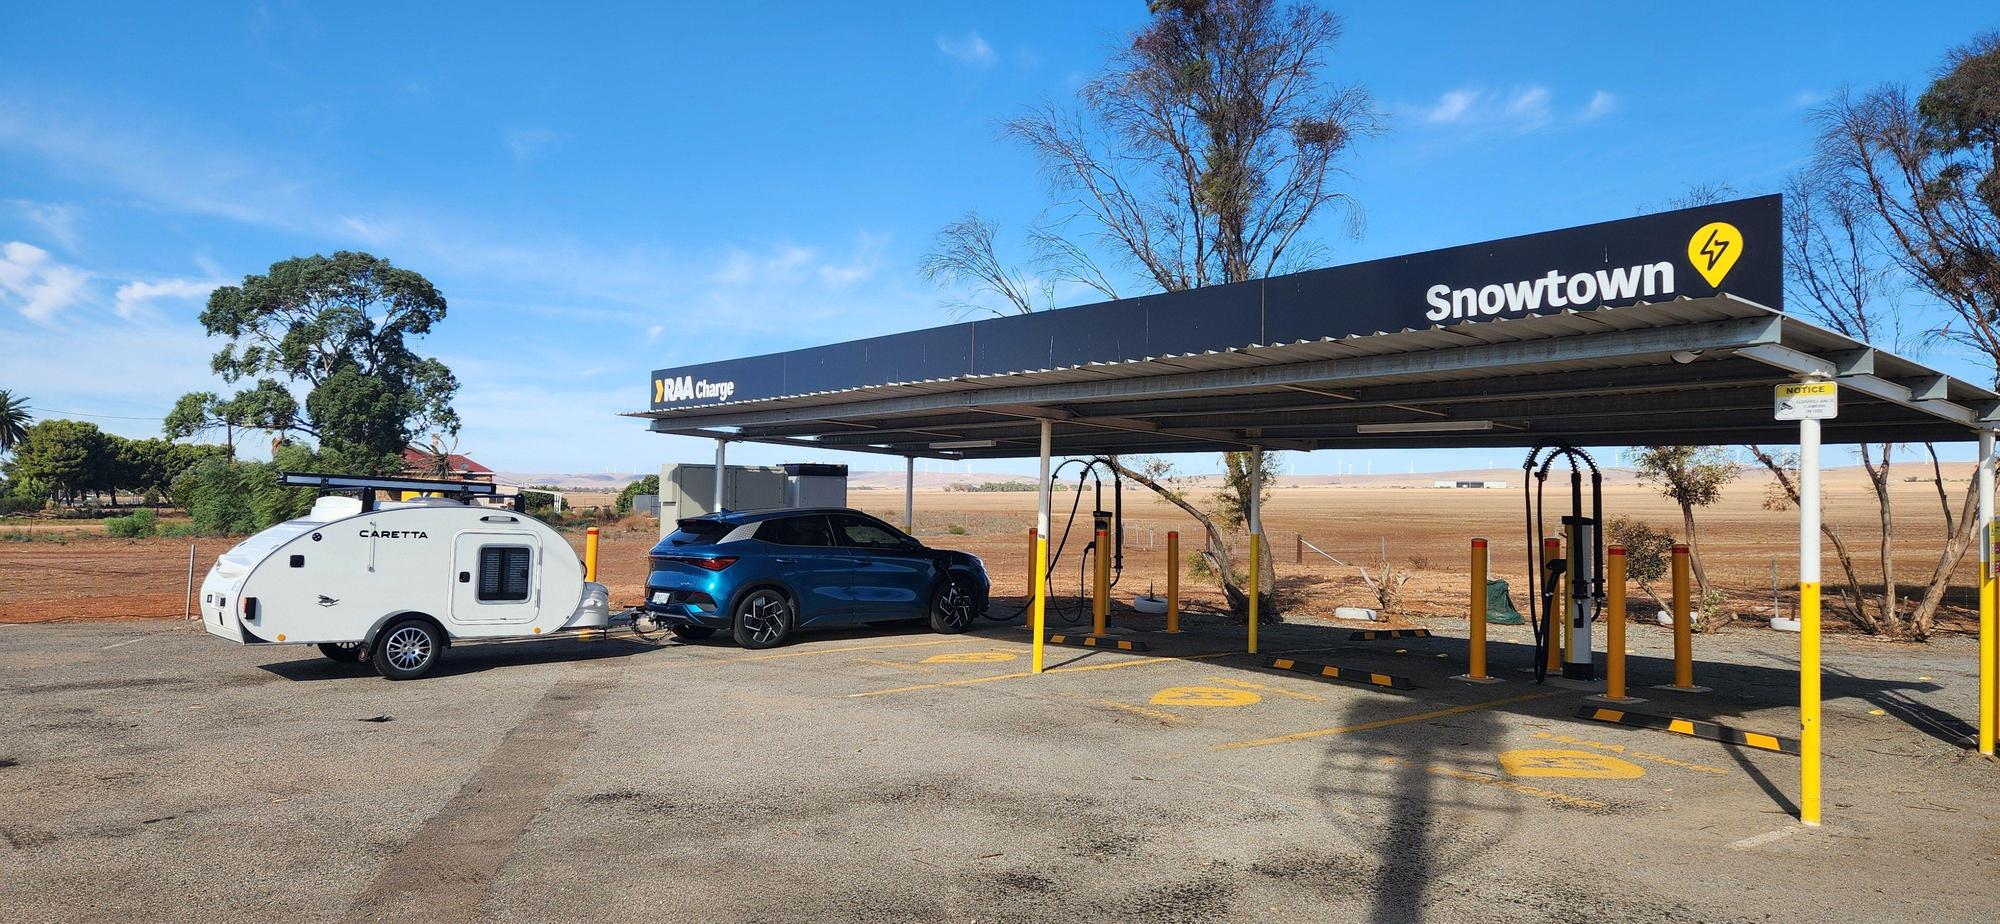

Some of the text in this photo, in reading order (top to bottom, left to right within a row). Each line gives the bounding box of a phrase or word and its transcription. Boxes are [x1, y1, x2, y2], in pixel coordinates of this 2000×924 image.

[1425, 260, 1675, 322] Snowtown
[664, 375, 734, 402] RAA Charge
[1786, 385, 1825, 394] NOTICE
[359, 530, 428, 539] CARETTA
